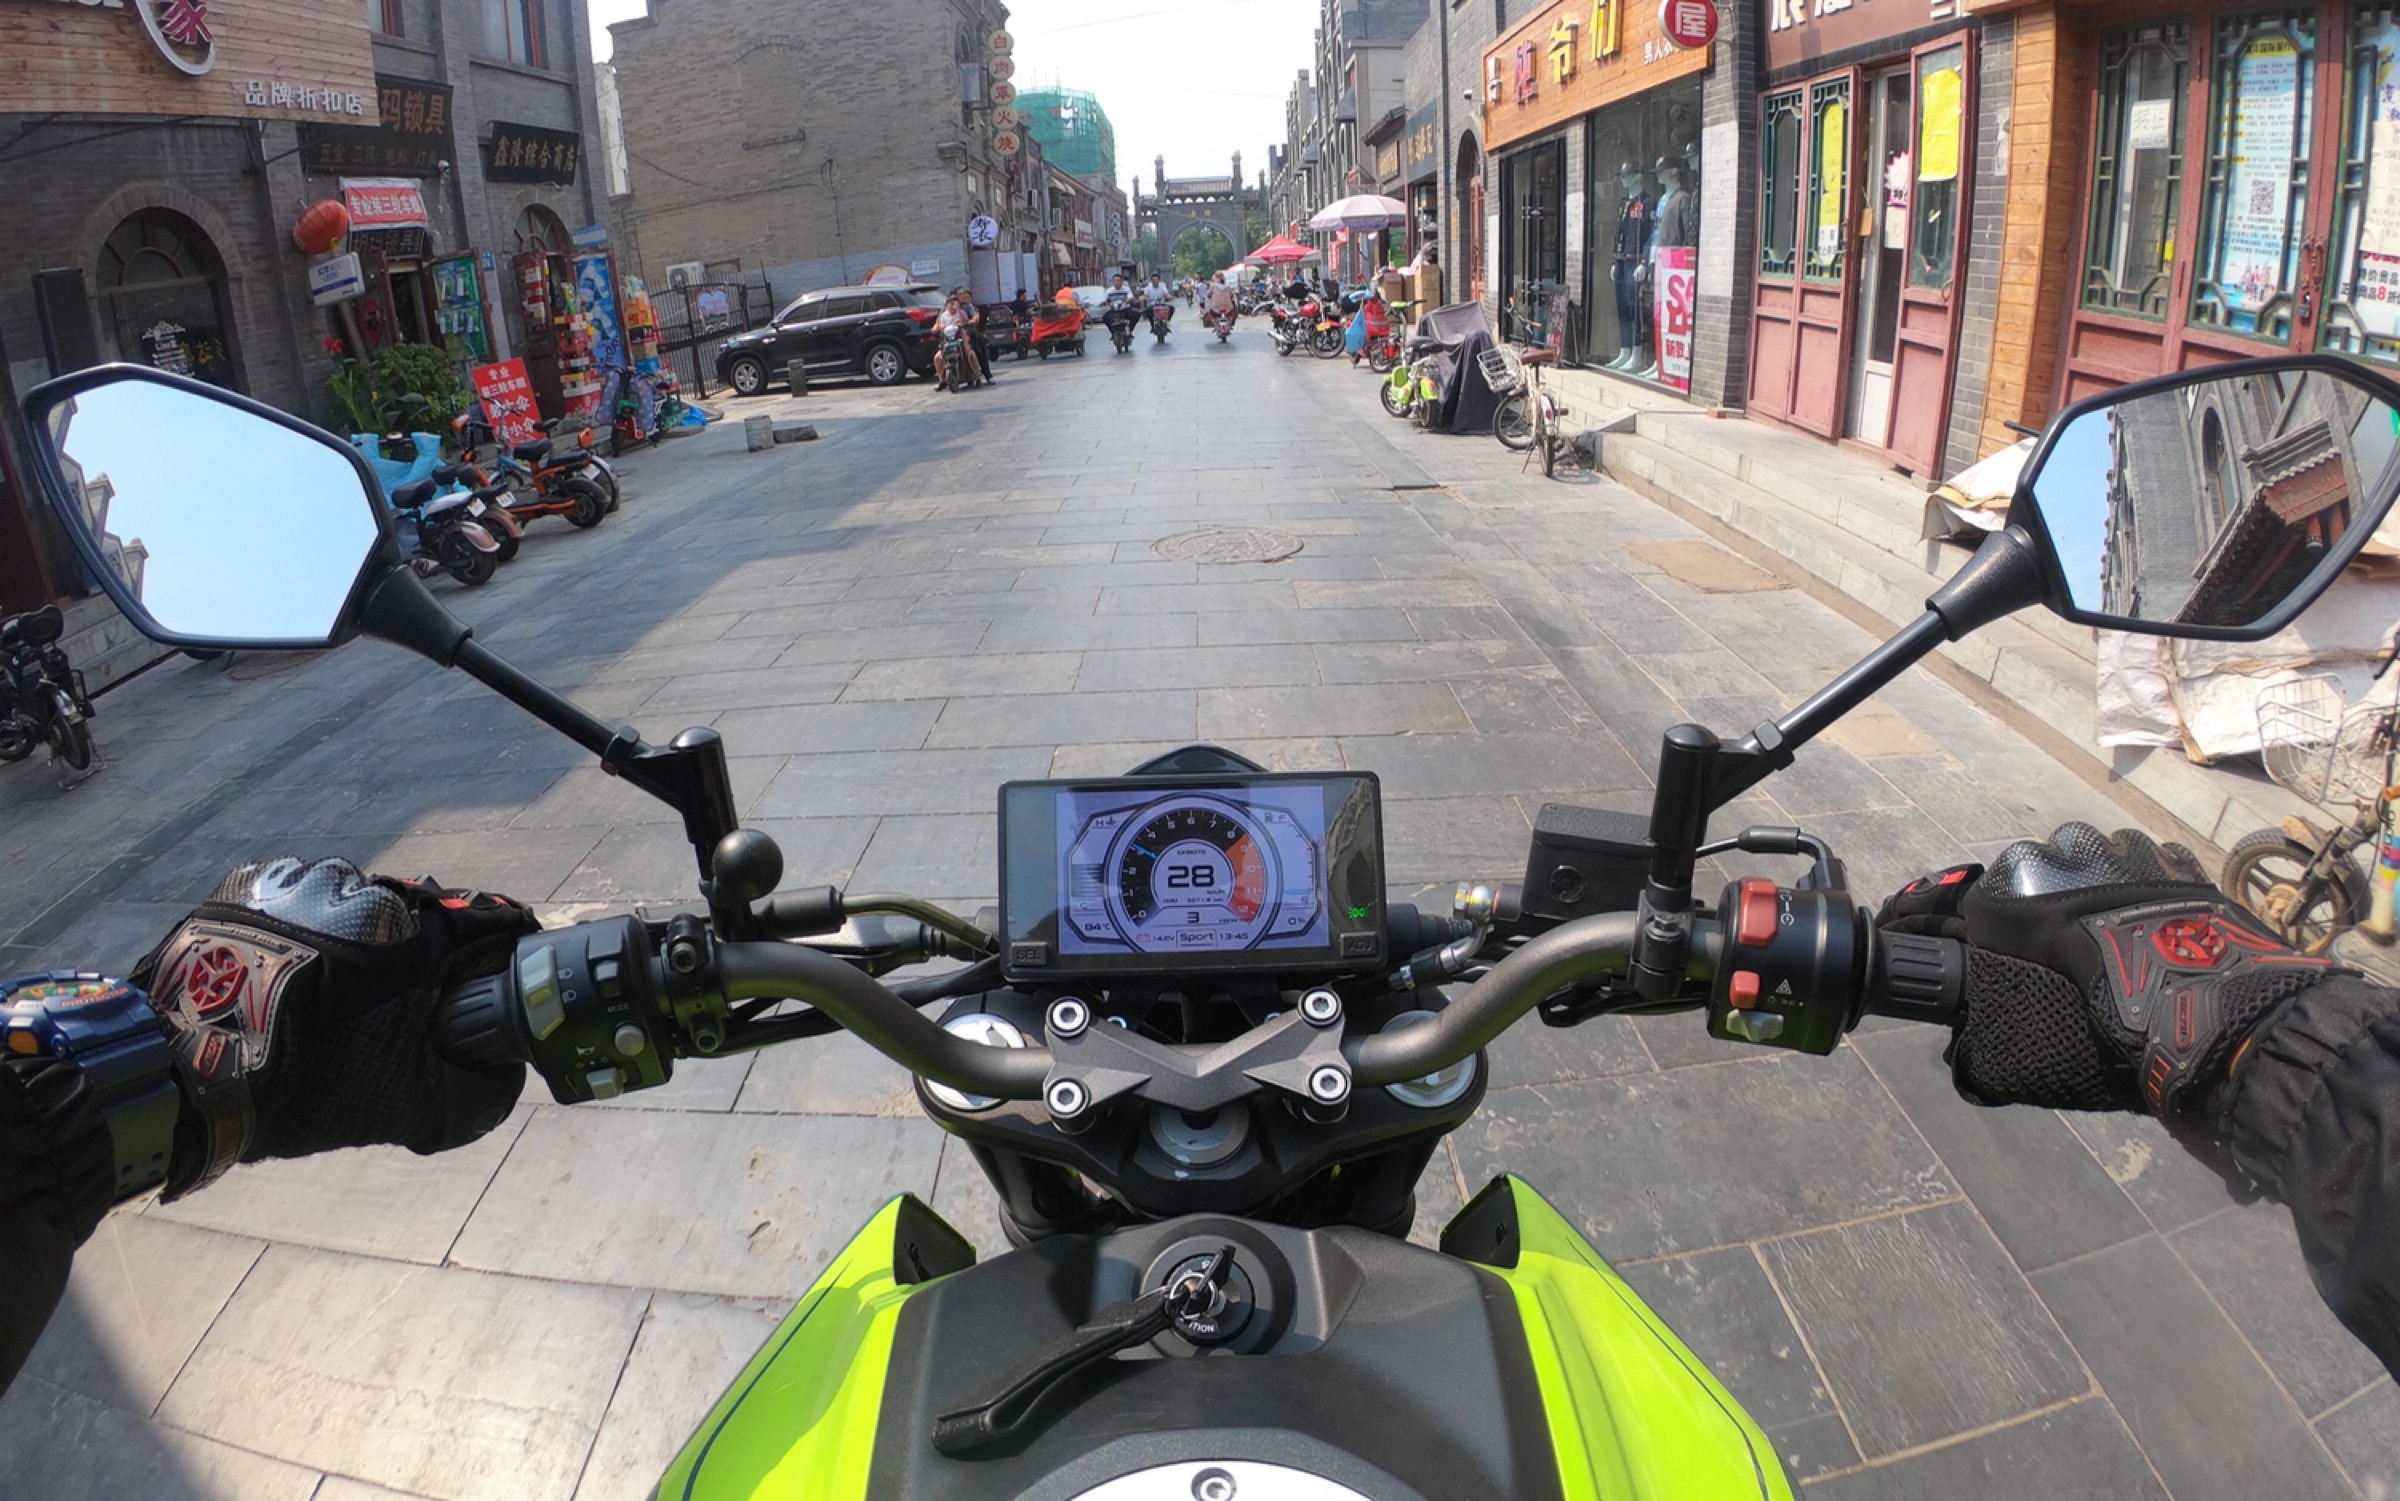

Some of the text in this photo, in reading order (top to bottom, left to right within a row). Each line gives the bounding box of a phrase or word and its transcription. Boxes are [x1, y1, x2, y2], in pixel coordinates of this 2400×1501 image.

[245, 79, 363, 115] 品牌折扣店
[1167, 865, 1215, 889] 28
[1186, 911, 1200, 923] 3
[1179, 931, 1215, 942] Sport
[1219, 932, 1249, 940] 13:45
[1017, 949, 1042, 961] SEL
